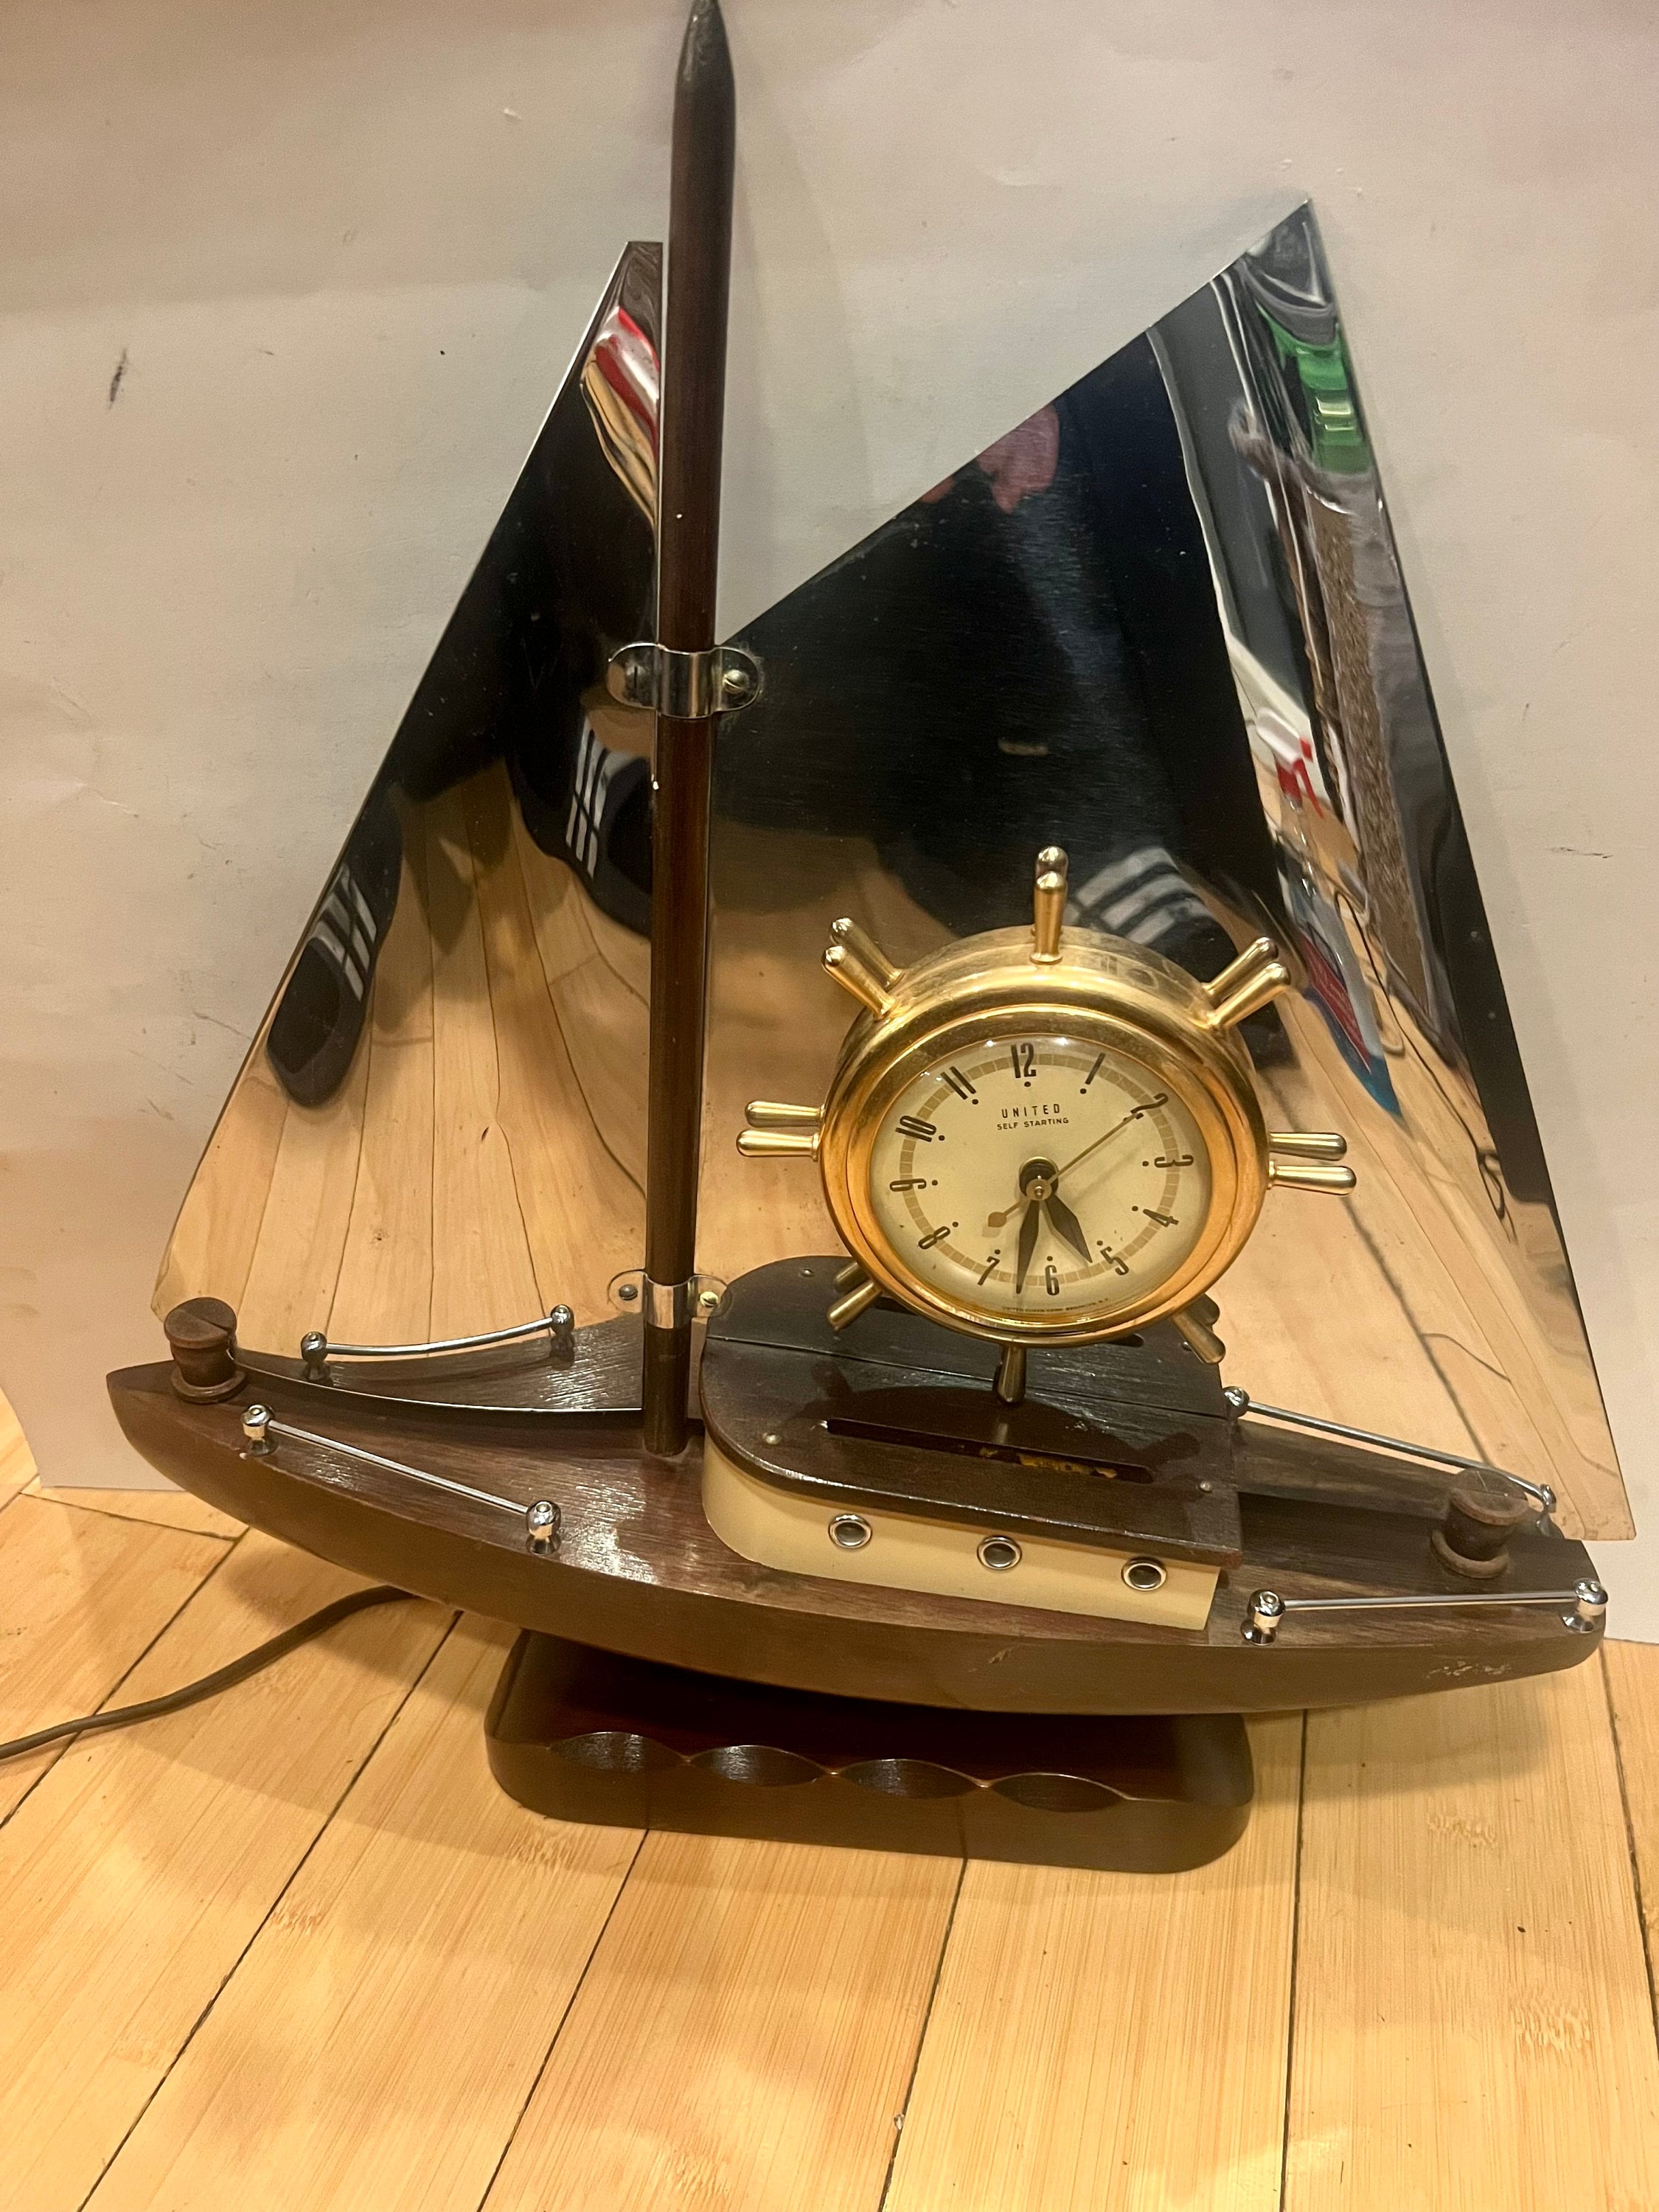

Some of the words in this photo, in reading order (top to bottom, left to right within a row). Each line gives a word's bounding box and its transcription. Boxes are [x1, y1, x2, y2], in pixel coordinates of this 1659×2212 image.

[1010, 1043, 1037, 1079] 12
[1085, 1052, 1106, 1085] 1
[939, 1065, 977, 1100] 11
[1001, 1103, 1060, 1119] UNITED
[1130, 1092, 1169, 1120] 2
[894, 1115, 937, 1142] 10
[996, 1121, 1019, 1130] SELF
[1023, 1117, 1070, 1128] STARTING
[1154, 1154, 1194, 1168] 3
[889, 1178, 928, 1192] 9
[1142, 1208, 1179, 1228] 4
[918, 1225, 951, 1250] 8
[977, 1256, 1001, 1286] 7
[1099, 1246, 1130, 1276] 5
[1045, 1265, 1060, 1296] 6
